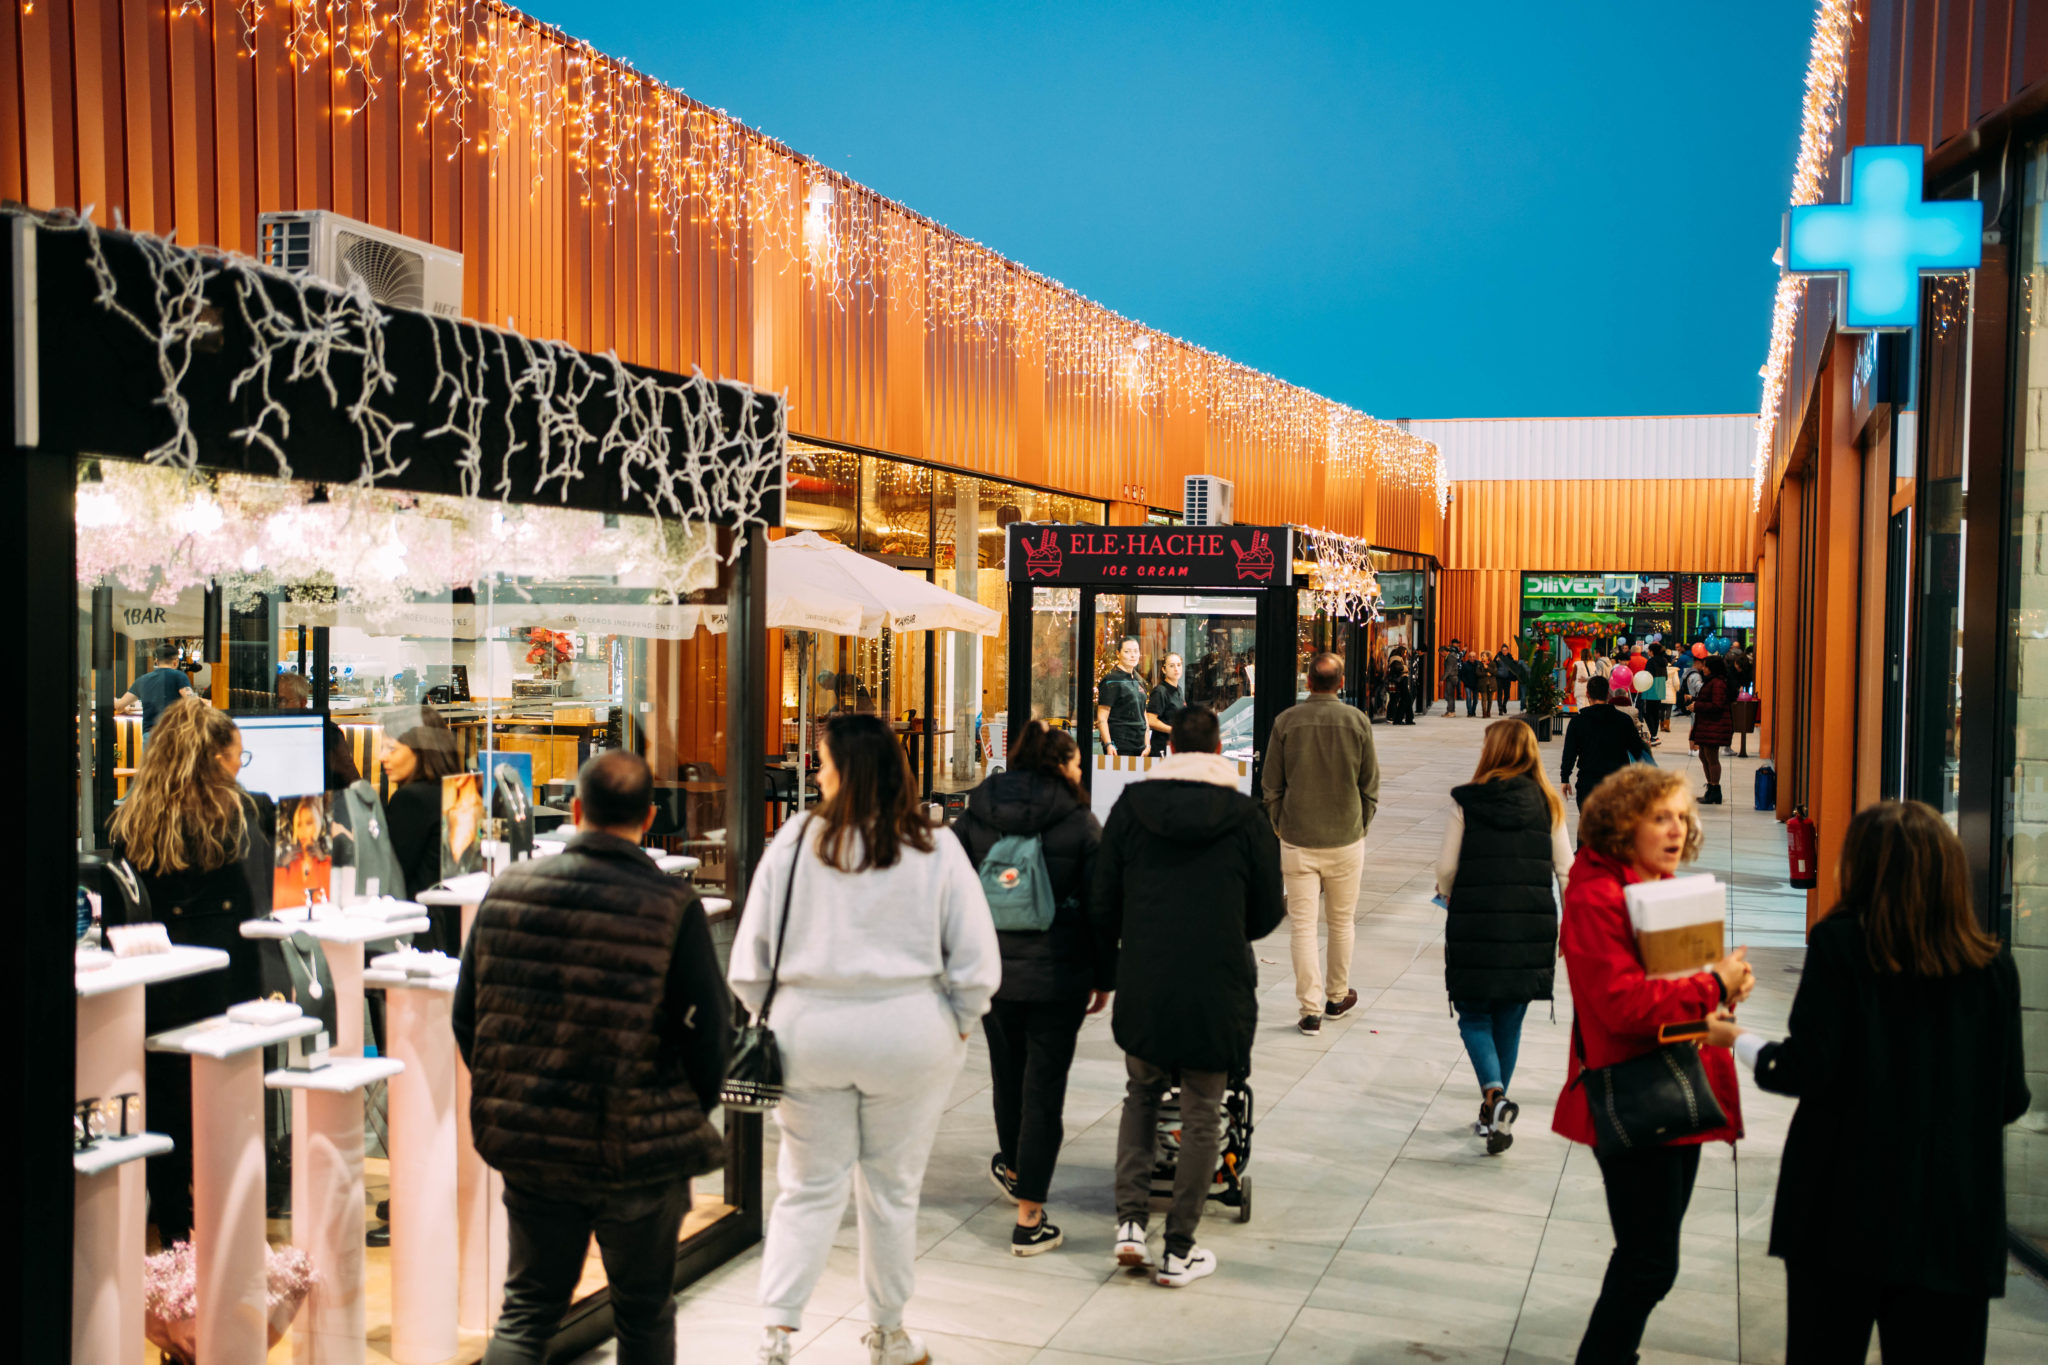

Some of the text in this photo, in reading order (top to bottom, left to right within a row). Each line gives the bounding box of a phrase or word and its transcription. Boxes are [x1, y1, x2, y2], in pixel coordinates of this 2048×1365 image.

[1102, 565, 1189, 577] ICE CREAM
[1609, 578, 1671, 593] JUMP
[1540, 597, 1652, 608] TRAMPOLINE PARK
